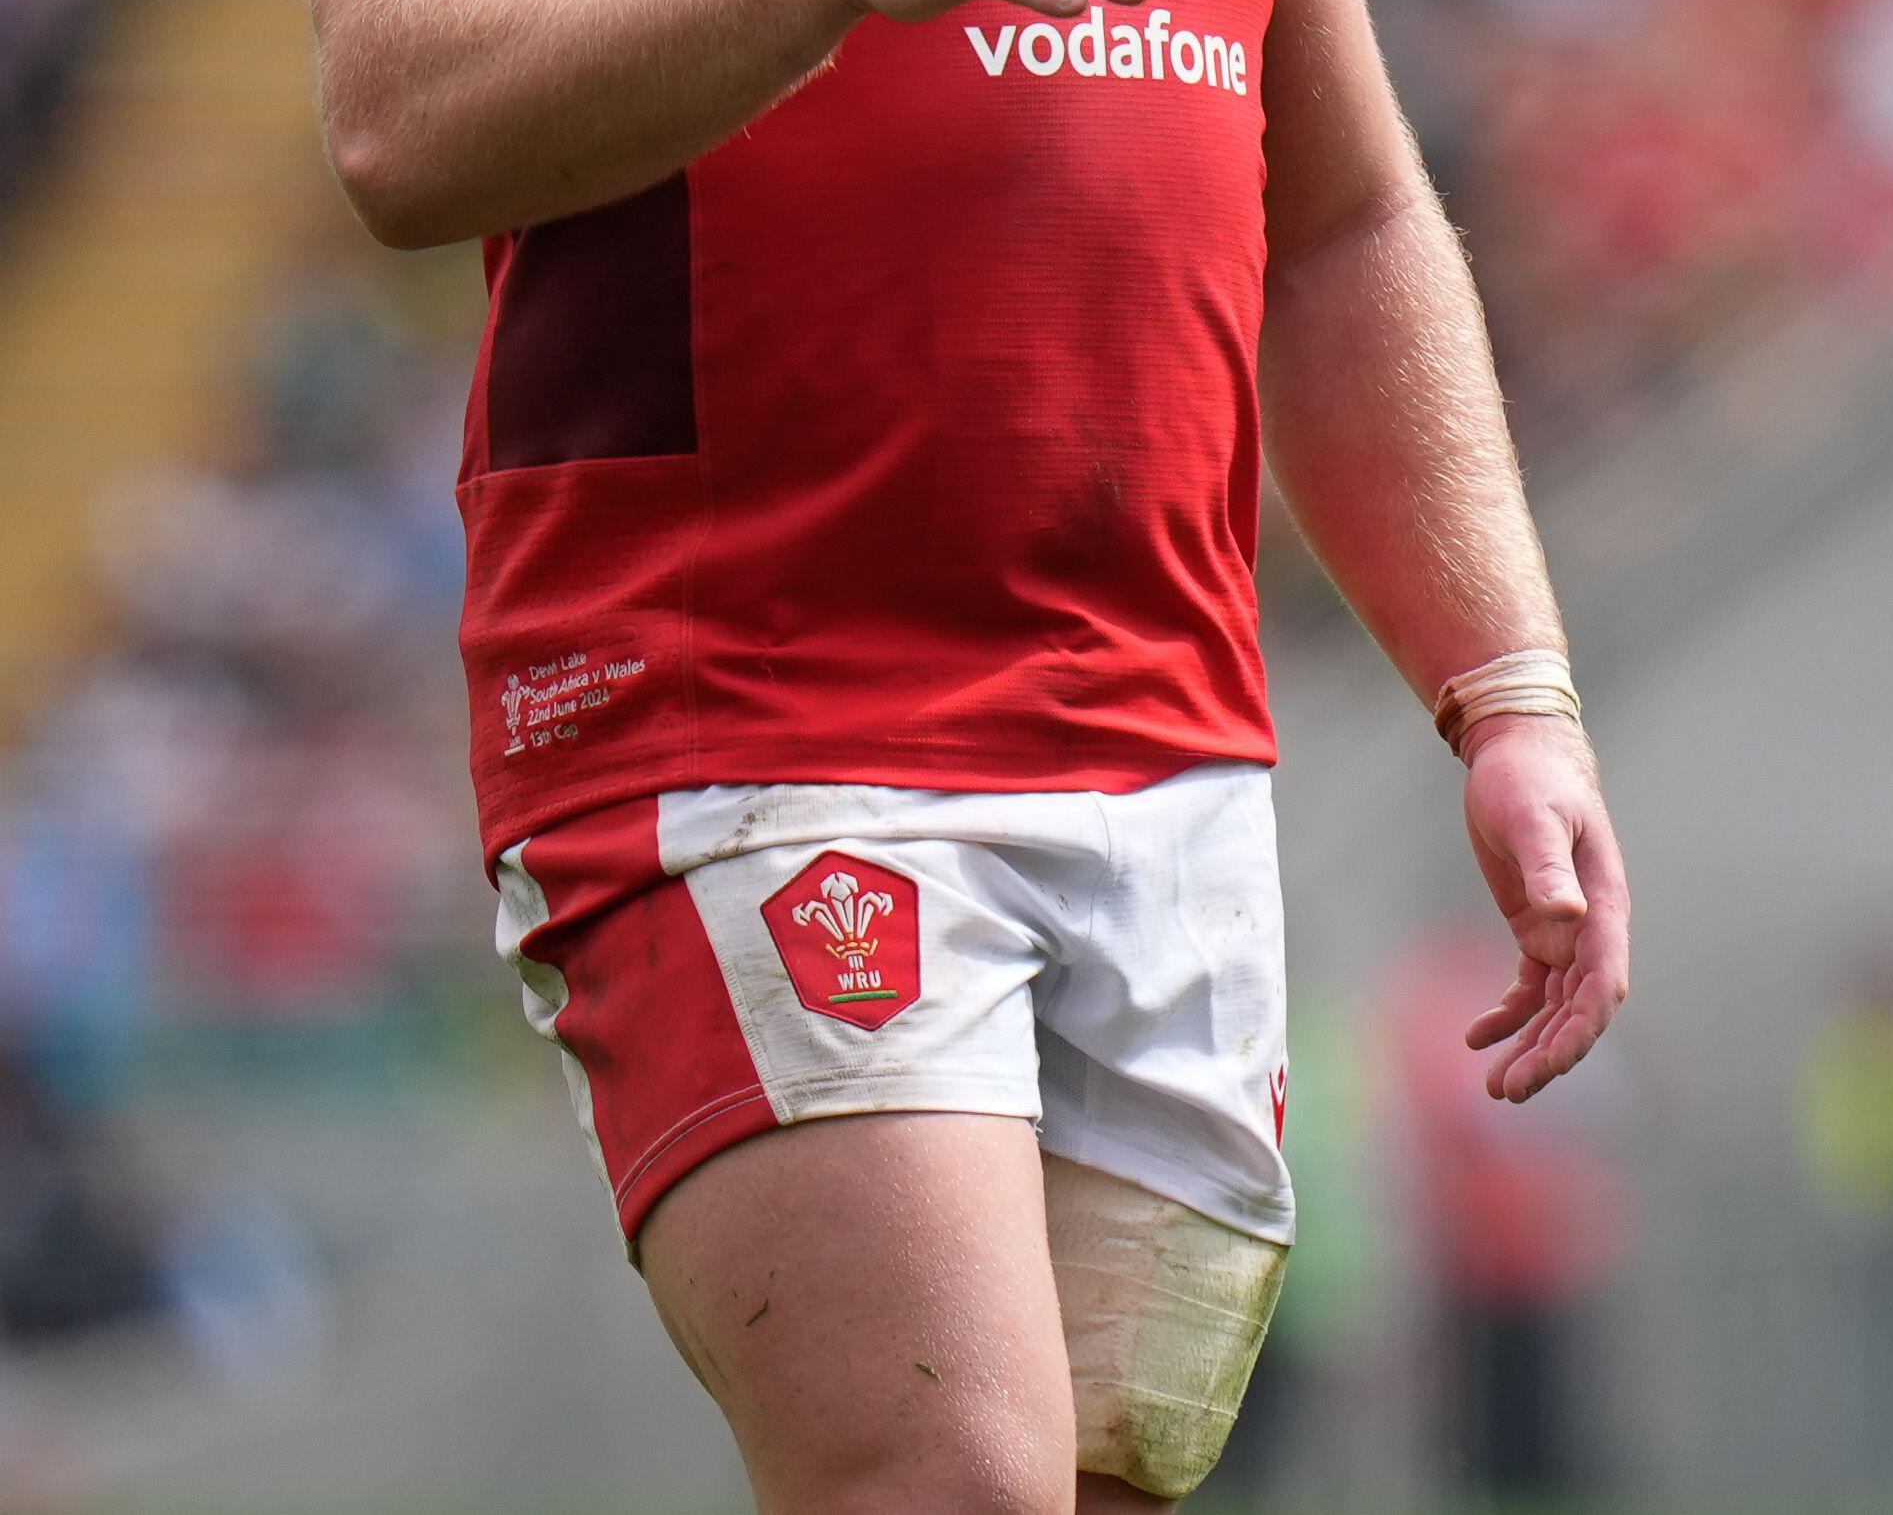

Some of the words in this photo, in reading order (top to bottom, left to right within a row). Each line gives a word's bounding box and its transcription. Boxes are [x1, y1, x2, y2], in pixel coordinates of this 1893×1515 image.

[963, 5, 1247, 96] vodafone
[560, 651, 587, 671] Lake
[529, 680, 558, 705] South
[592, 669, 601, 684] v
[604, 658, 646, 680] Wales
[526, 701, 550, 728] 22nd
[551, 699, 578, 719] June
[578, 686, 612, 711] 2024
[530, 728, 553, 748] 13th
[553, 722, 579, 741] Cap
[837, 969, 882, 991] WRU
